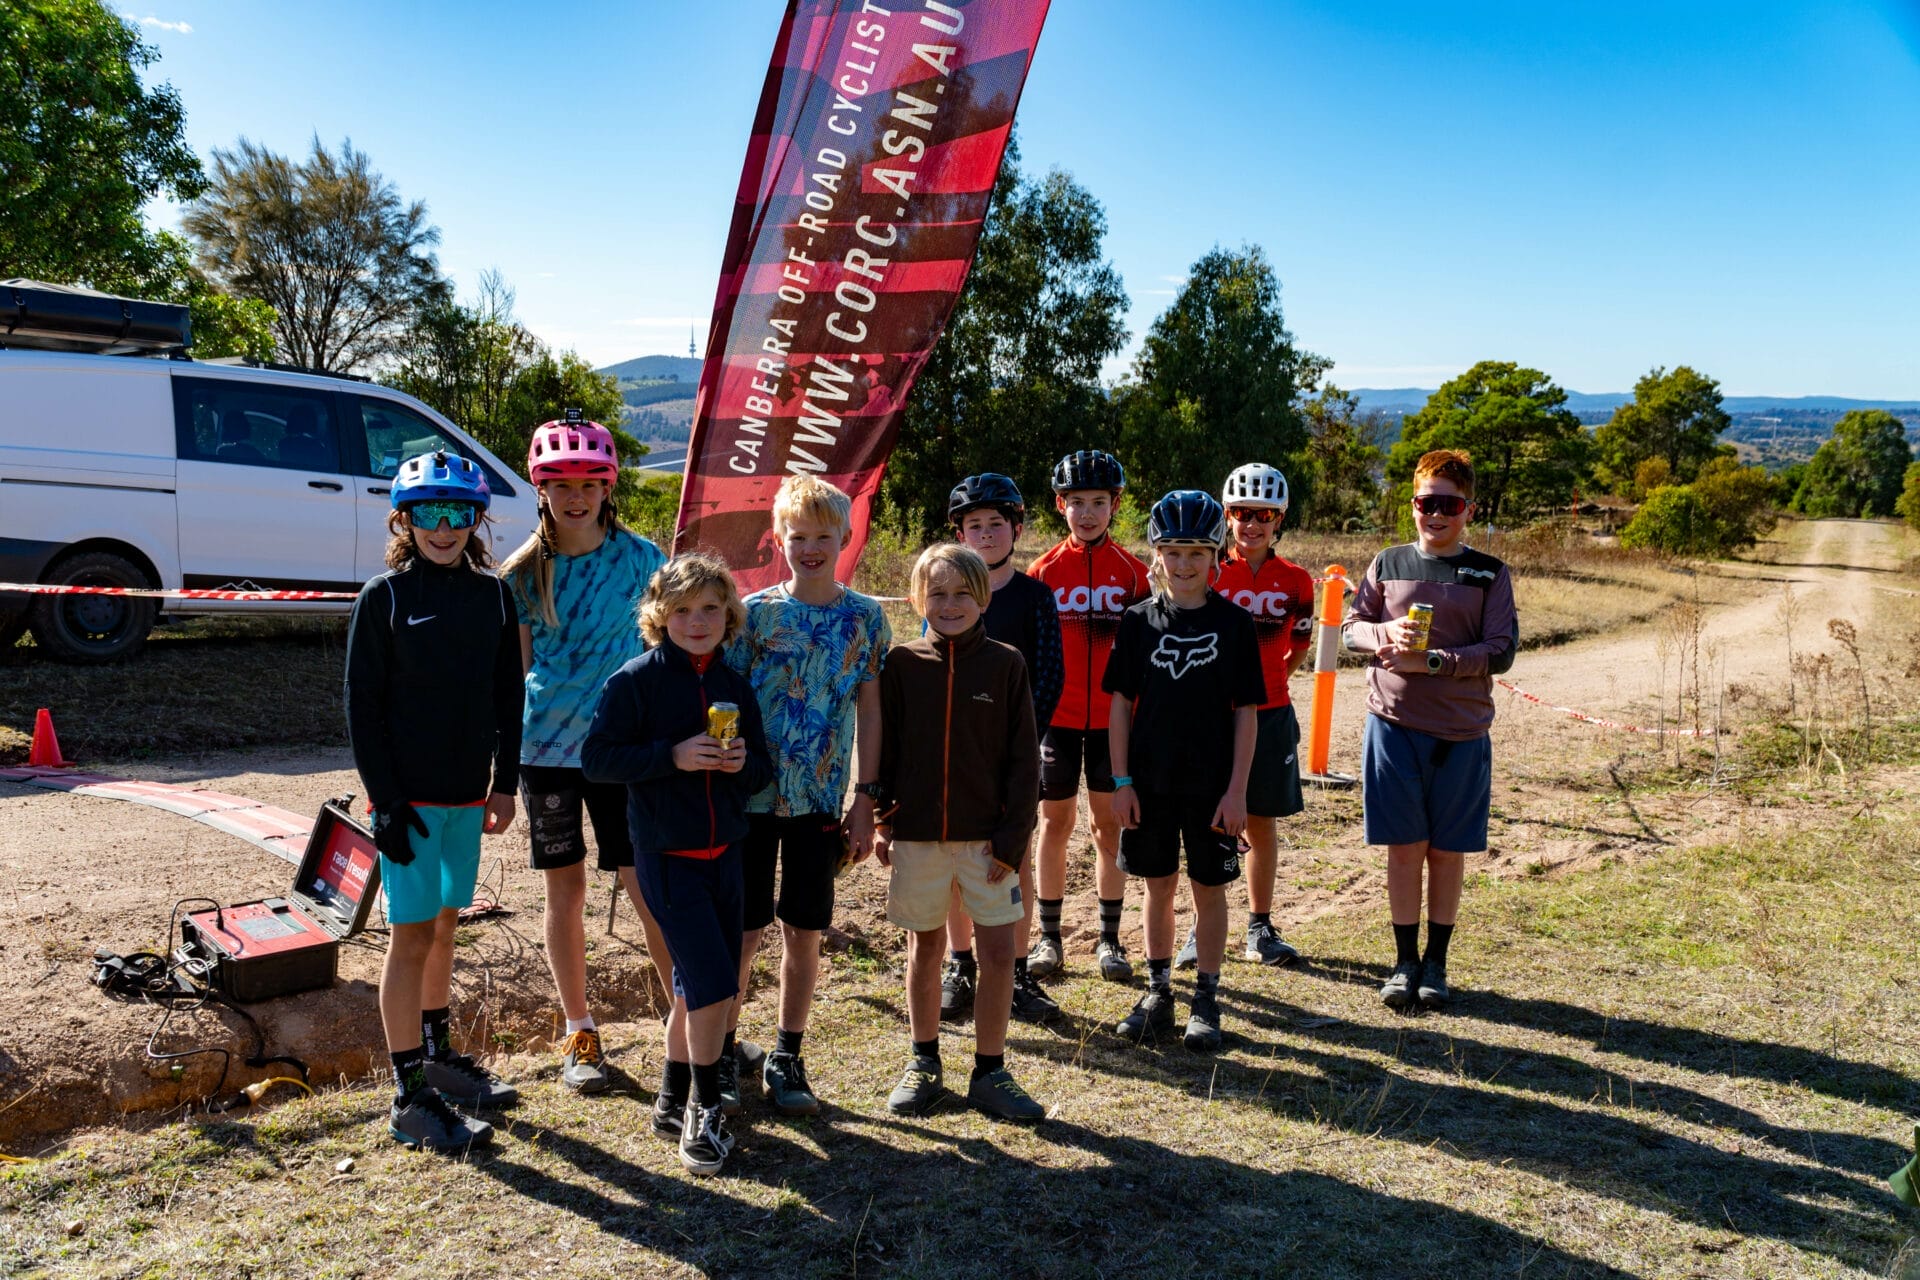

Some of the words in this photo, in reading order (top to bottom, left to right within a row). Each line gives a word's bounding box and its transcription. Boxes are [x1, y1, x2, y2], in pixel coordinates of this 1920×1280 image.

[730, 317, 798, 474] CANBERRA
[778, 147, 847, 305] OFF-ROAD
[827, 0, 891, 136] CYCLIST
[1219, 589, 1289, 617] orc
